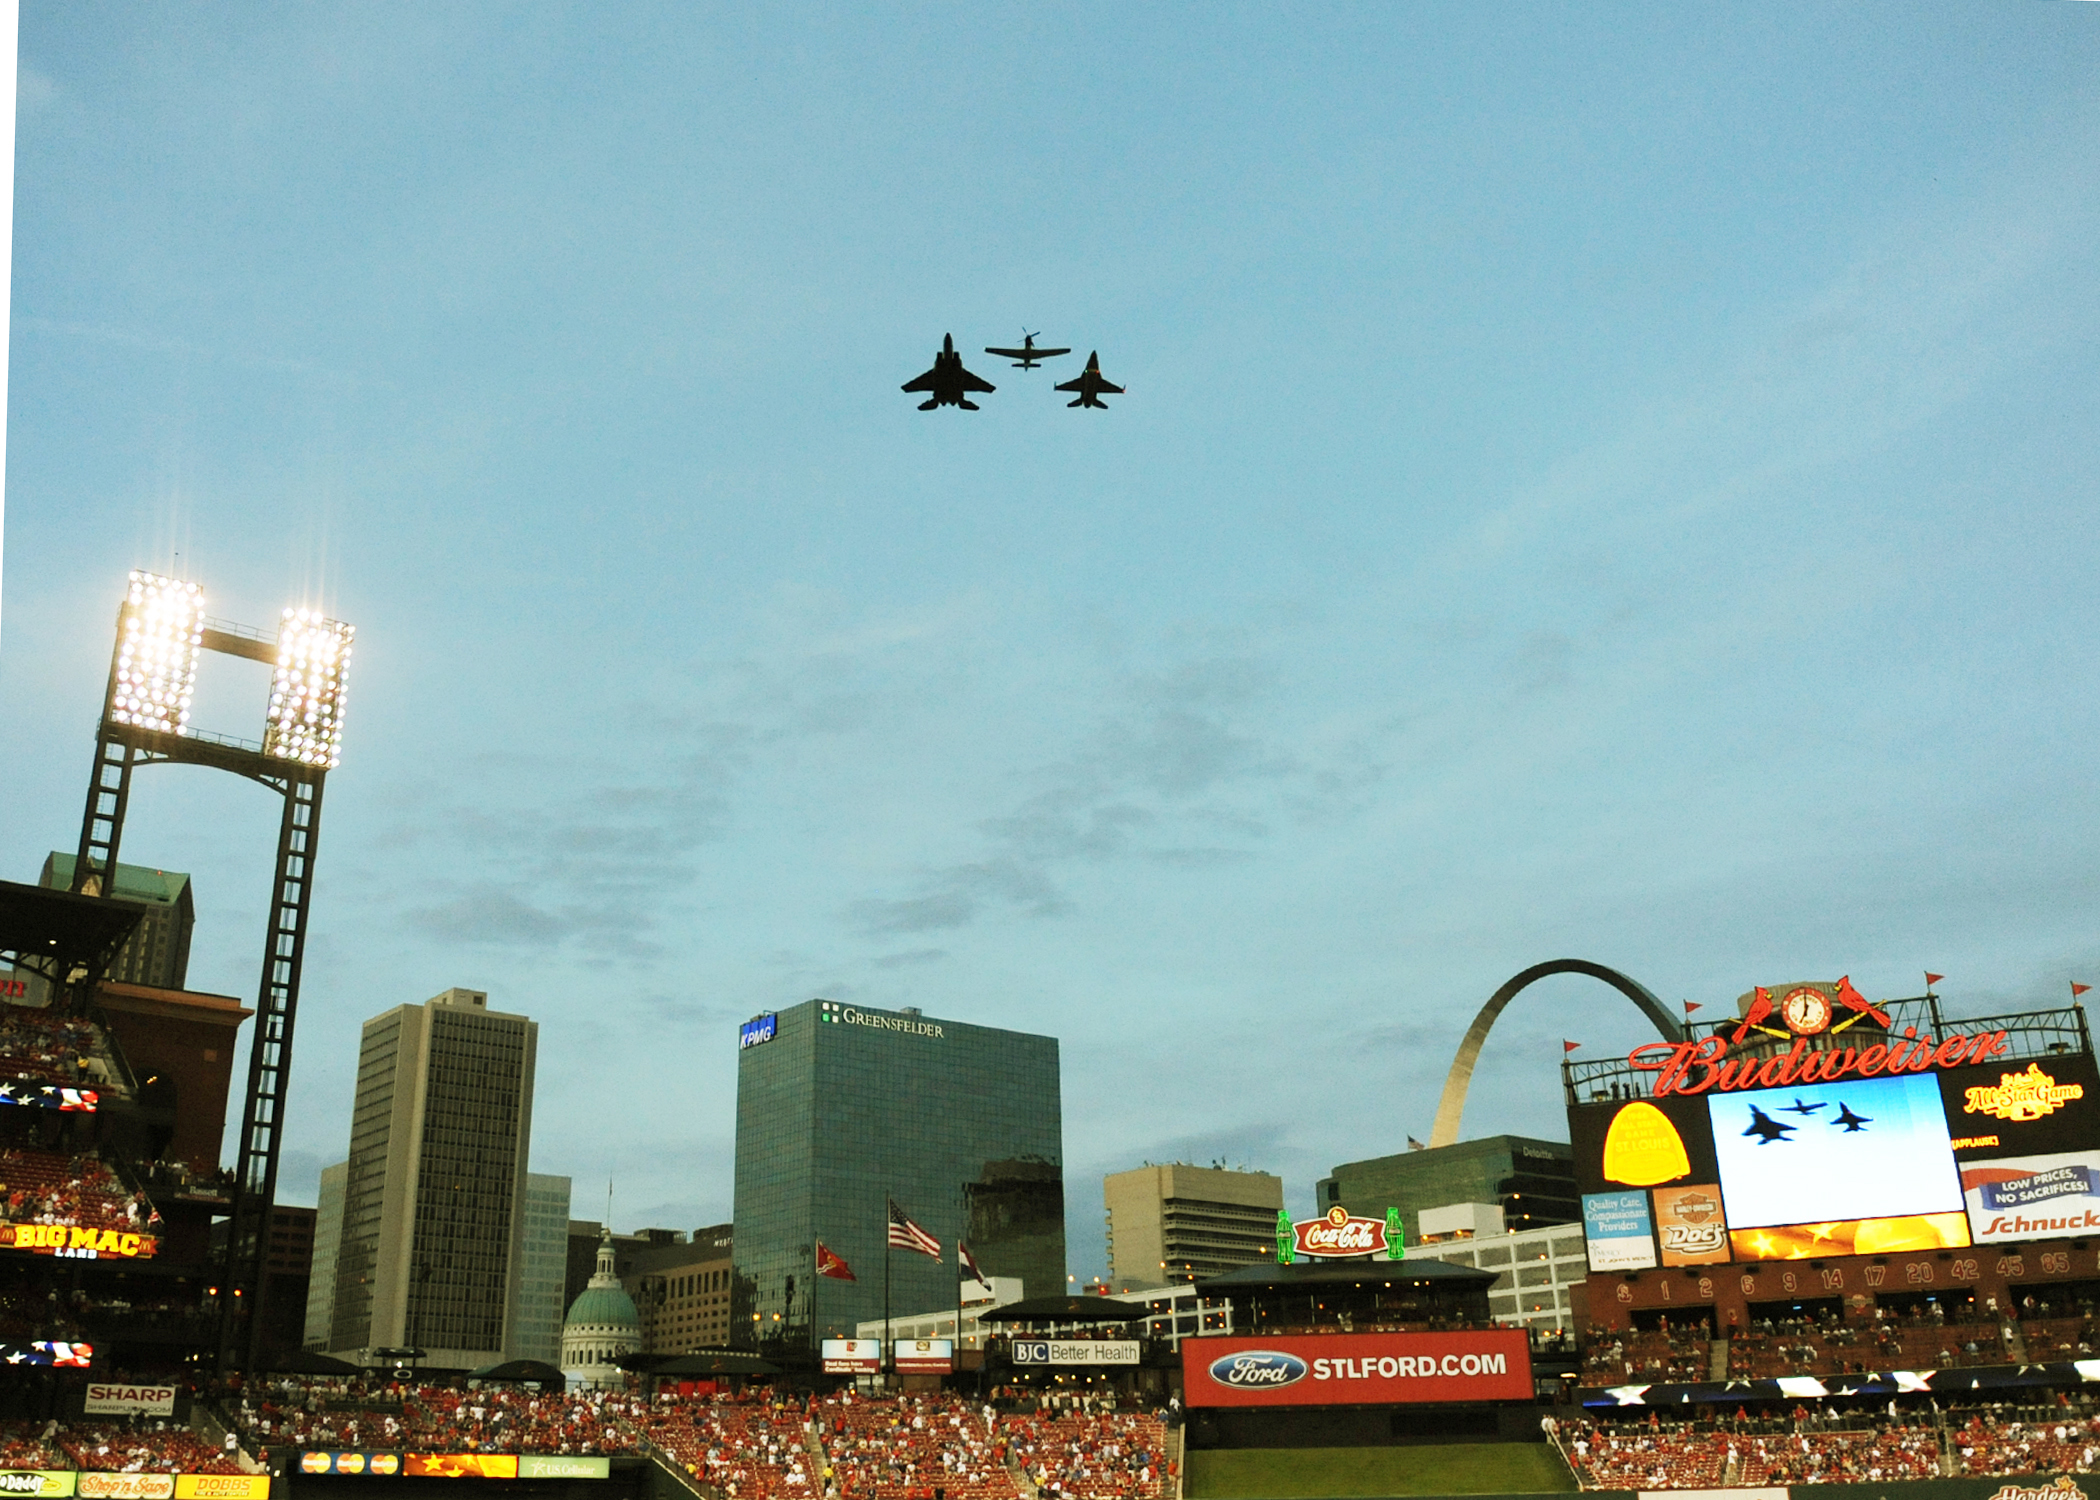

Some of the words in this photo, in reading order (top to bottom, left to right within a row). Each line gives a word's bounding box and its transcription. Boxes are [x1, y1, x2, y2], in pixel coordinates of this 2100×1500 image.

[740, 1026, 772, 1050] KPMG
[1628, 1027, 2008, 1099] Budweiser
[1625, 1129, 1656, 1139] GAME
[1632, 1137, 1671, 1151] LOUIS
[2001, 1179, 2030, 1192] LOW
[2033, 1168, 2078, 1186] PRICES,
[1995, 1193, 2017, 1203] NO
[2019, 1180, 2090, 1202] SACRIFICES!
[1588, 1199, 1618, 1211] Quality
[1586, 1209, 1647, 1222] Compassionate
[1598, 1221, 1638, 1232] Providers
[14, 1225, 67, 1248] BIG
[69, 1227, 141, 1257] MAC
[54, 1247, 98, 1259] LAND
[1661, 1281, 1669, 1299] 1
[1699, 1277, 1713, 1297] 2
[1741, 1275, 1754, 1294] 6
[1783, 1273, 1796, 1292] 9
[1822, 1269, 1843, 1289] 14
[1864, 1266, 1886, 1286] 17
[1906, 1262, 1934, 1284] 20
[1951, 1259, 1980, 1280] 42
[1997, 1255, 2024, 1277] 45
[2041, 1252, 2070, 1273] 85
[1017, 1343, 1046, 1362] BJC
[1051, 1345, 1089, 1360] Better
[1095, 1345, 1137, 1360] Health
[1229, 1356, 1288, 1383] Ford
[1313, 1353, 1507, 1380] STLFORD.COM
[89, 1386, 172, 1402] SHARP
[562, 1464, 596, 1475] Cellular
[82, 1475, 119, 1493] Shop
[133, 1477, 170, 1494] Save
[197, 1478, 252, 1490] DOBBS
